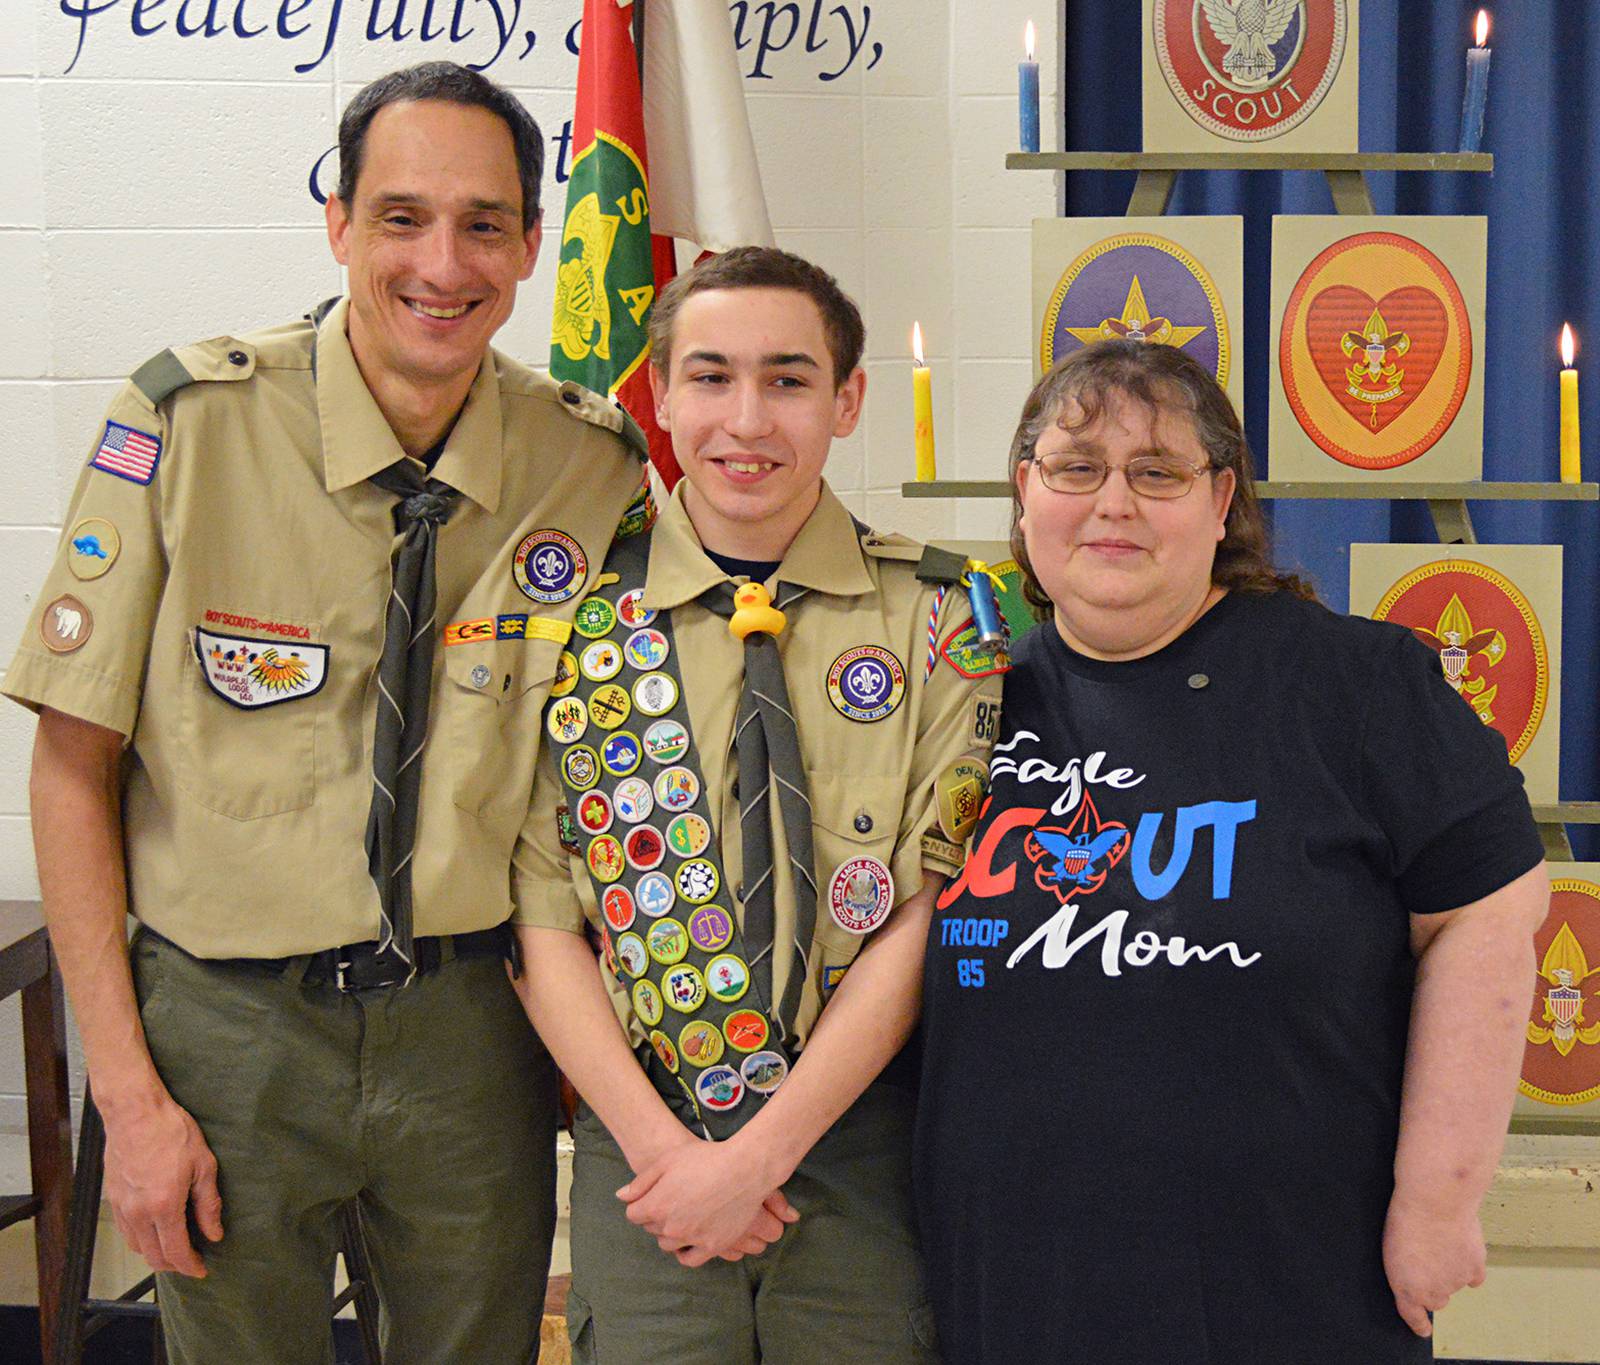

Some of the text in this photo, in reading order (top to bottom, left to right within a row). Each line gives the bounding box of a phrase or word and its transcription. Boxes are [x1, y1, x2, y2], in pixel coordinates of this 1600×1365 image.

[1193, 78, 1301, 124] SCOUT
[204, 609, 222, 624] BOY
[223, 612, 258, 630] SCOUTS
[266, 622, 311, 640] AMERICA
[975, 701, 998, 740] 85
[955, 766, 973, 777] DEN
[988, 731, 1147, 816] Eagle
[864, 861, 886, 880] SCOUT
[941, 918, 1009, 948] TROOP
[1006, 903, 1262, 977] Mom
[957, 959, 985, 989] 85
